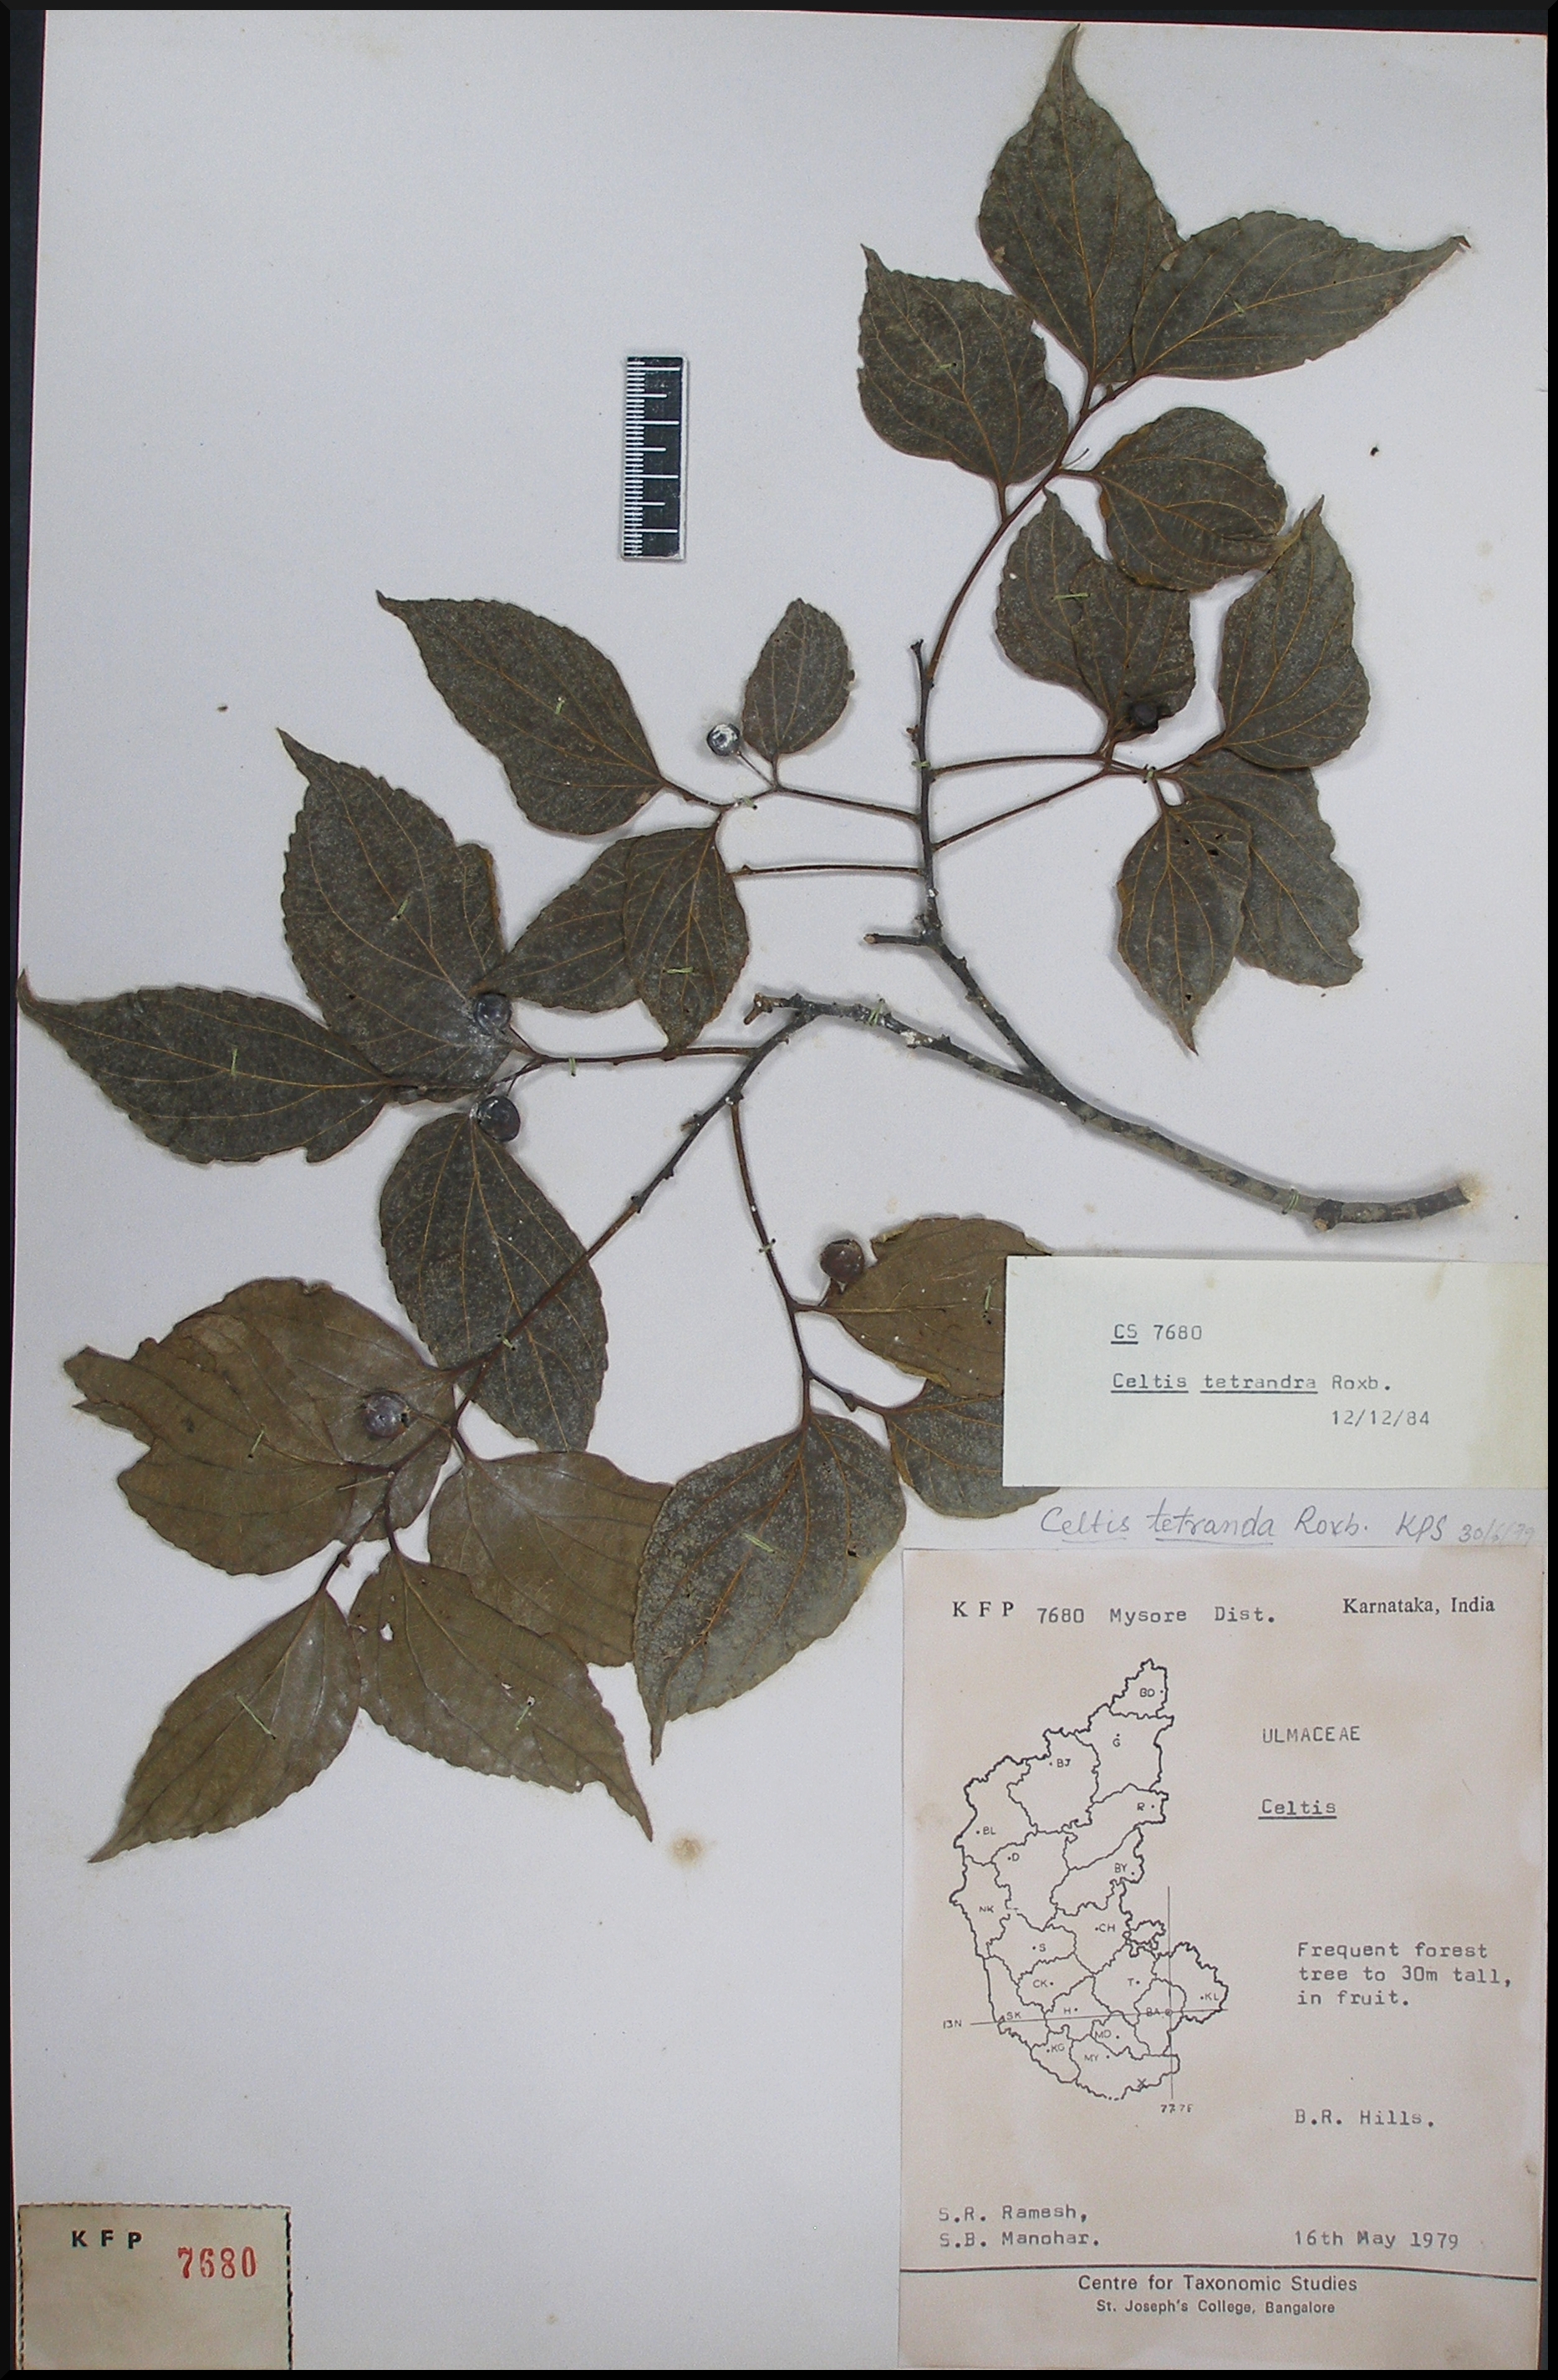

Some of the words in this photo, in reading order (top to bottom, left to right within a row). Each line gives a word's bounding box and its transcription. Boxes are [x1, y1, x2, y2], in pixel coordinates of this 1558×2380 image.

[1112, 1324, 1138, 1340] CS
[1153, 1324, 1203, 1341] 7680
[1112, 1373, 1189, 1390] Celtis
[1203, 1373, 1318, 1390] tetrandra
[1331, 1374, 1391, 1391] Roxb.
[1331, 1409, 1429, 1427] 12/12/84
[1041, 1506, 1131, 1535] Celtis
[1147, 1498, 1275, 1539] tetranda
[1295, 1508, 1369, 1538] Roxb.
[1342, 1596, 1440, 1615] Karnataka,
[1451, 1595, 1496, 1614] India
[1036, 1606, 1085, 1625] 7680
[1109, 1608, 1187, 1627] Mysore
[1214, 1606, 1275, 1624] Dist.
[1139, 1688, 1155, 1697] BD
[1262, 1725, 1361, 1744] ULMACEAE
[1056, 1758, 1072, 1767] BJ
[1260, 1798, 1337, 1815] Celtis
[983, 1826, 995, 1835] BL
[1011, 1854, 1020, 1862] D
[1115, 1864, 1128, 1873] BY
[1099, 1924, 1115, 1932] CH
[1039, 1944, 1046, 1952] S
[1297, 1941, 1400, 1960] Frequent
[1414, 1941, 1488, 1959] forest
[1033, 1980, 1047, 1988] CK
[1128, 1978, 1134, 1986] T
[1298, 1966, 1348, 1981] tree
[1362, 1966, 1386, 1982] to
[1402, 1965, 1438, 1982] 30m
[1453, 1966, 1511, 1988] tall,
[1205, 1992, 1219, 2001] KL
[1297, 1990, 1321, 2006] in
[1337, 1989, 1409, 2006] fruit.
[943, 2019, 962, 2029] 13N
[1006, 2011, 1021, 2020] SK
[1295, 2108, 1342, 2126] B.R.
[1360, 2109, 1434, 2128] Hills.
[939, 2206, 986, 2224] S.R.
[1001, 2204, 1087, 2224] Ramesh,
[939, 2231, 987, 2249] S.B.
[1001, 2230, 1099, 2247] Manohar.
[1295, 2229, 1343, 2246] 16th
[1357, 2230, 1396, 2250] May
[1410, 2231, 1459, 2250] 1979
[177, 2246, 257, 2280] 7680
[1078, 2274, 1138, 2291] Centre
[1148, 2274, 1174, 2291] for
[1183, 2274, 1281, 2291] Taxonomic
[1291, 2275, 1357, 2291] Studies
[1096, 2299, 1117, 2312] St.
[1124, 2299, 1189, 2316] Joseph's
[1198, 2299, 1256, 2316] College,
[1265, 2301, 1336, 2316] Bangalore
